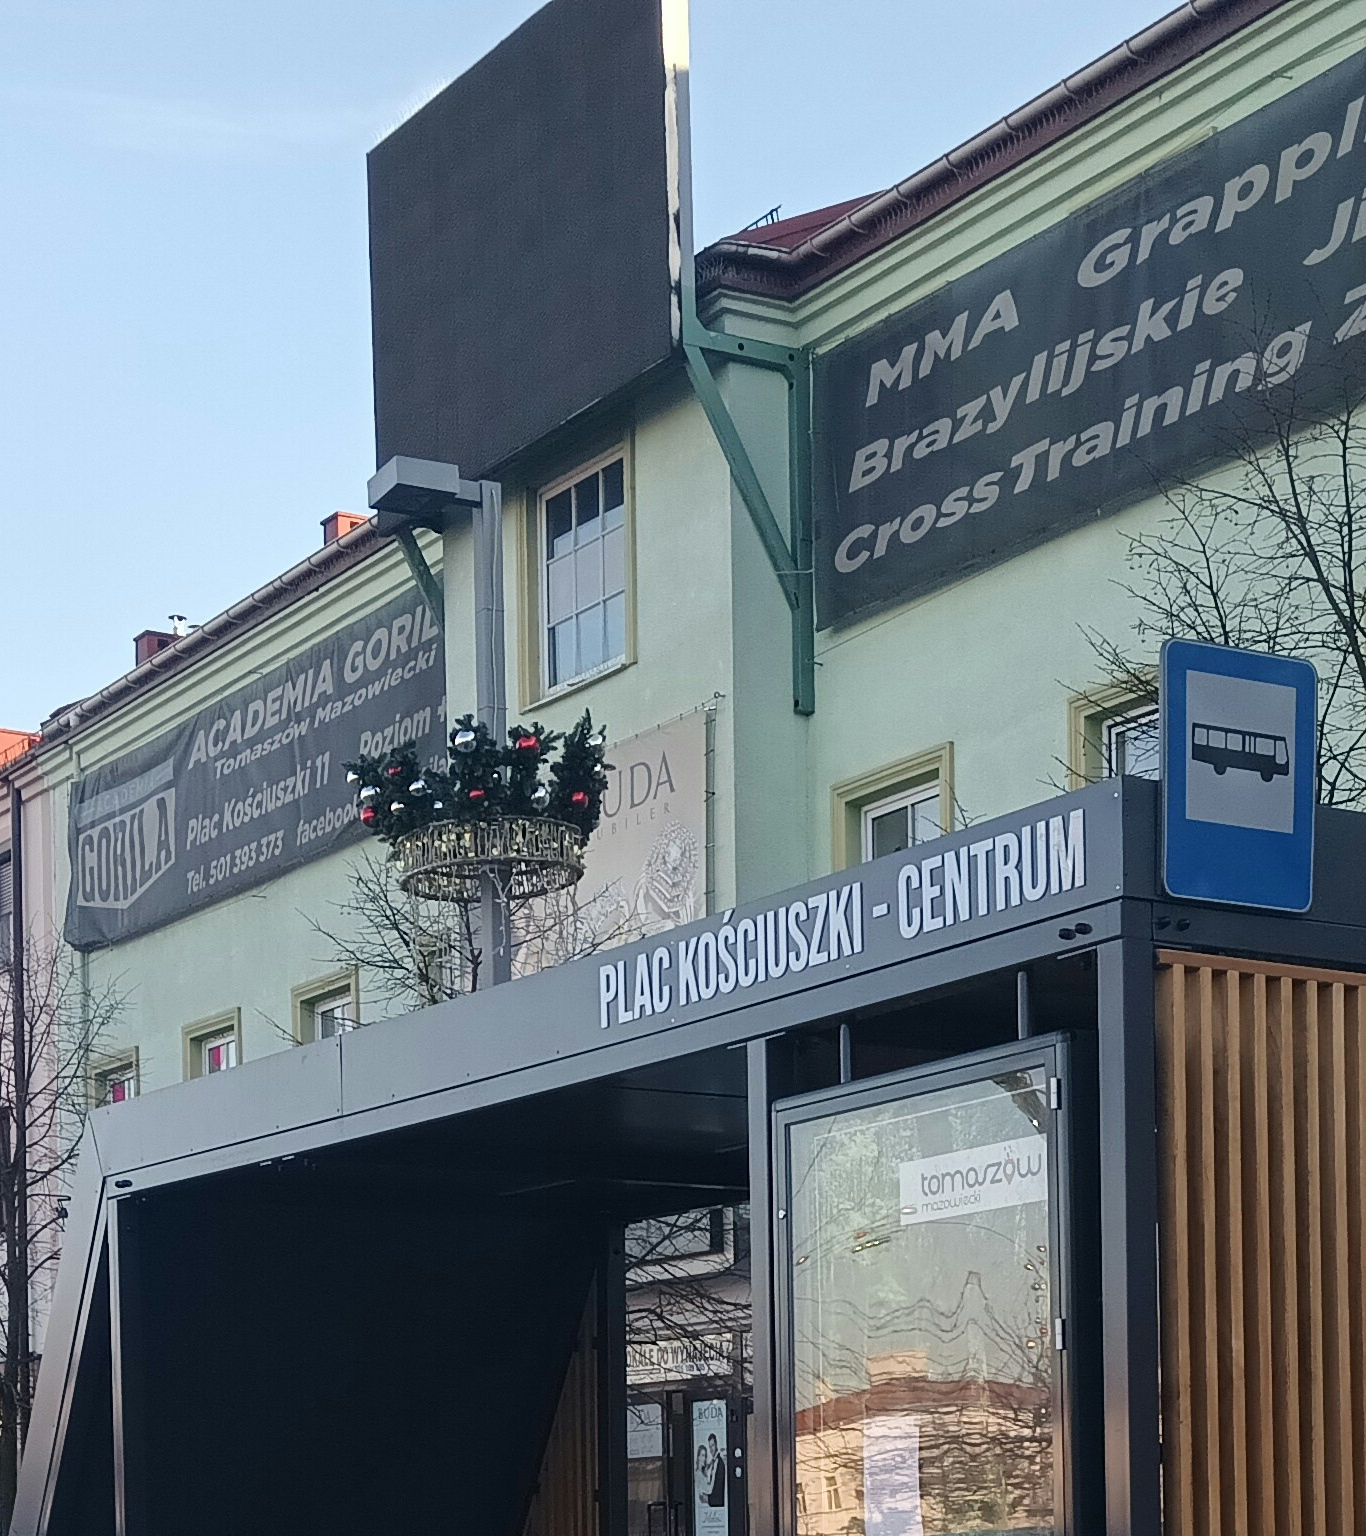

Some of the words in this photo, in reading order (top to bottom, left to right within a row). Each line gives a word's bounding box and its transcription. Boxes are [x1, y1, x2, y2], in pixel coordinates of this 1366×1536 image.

[849, 267, 1244, 492] Brazylijskie
[865, 289, 1020, 408] MMA
[187, 659, 333, 770] ACADEMIA
[215, 717, 309, 779] Tomaszów
[314, 644, 437, 728] Mazowiecki
[187, 815, 218, 850] Plac
[223, 758, 310, 833] Kościuszki
[315, 751, 330, 788] 11
[360, 706, 431, 759] Poziom
[81, 796, 173, 902] GORILA
[187, 867, 206, 895] Tel.
[209, 853, 231, 885] 501
[233, 842, 257, 875] 393
[259, 830, 284, 863] 373
[598, 947, 671, 1029] PLAC
[678, 881, 863, 1008] KOŚCIUSZKI
[873, 901, 889, 919] -
[897, 808, 1086, 940] CENTRUM
[922, 1190, 981, 1213] mazowiecki
